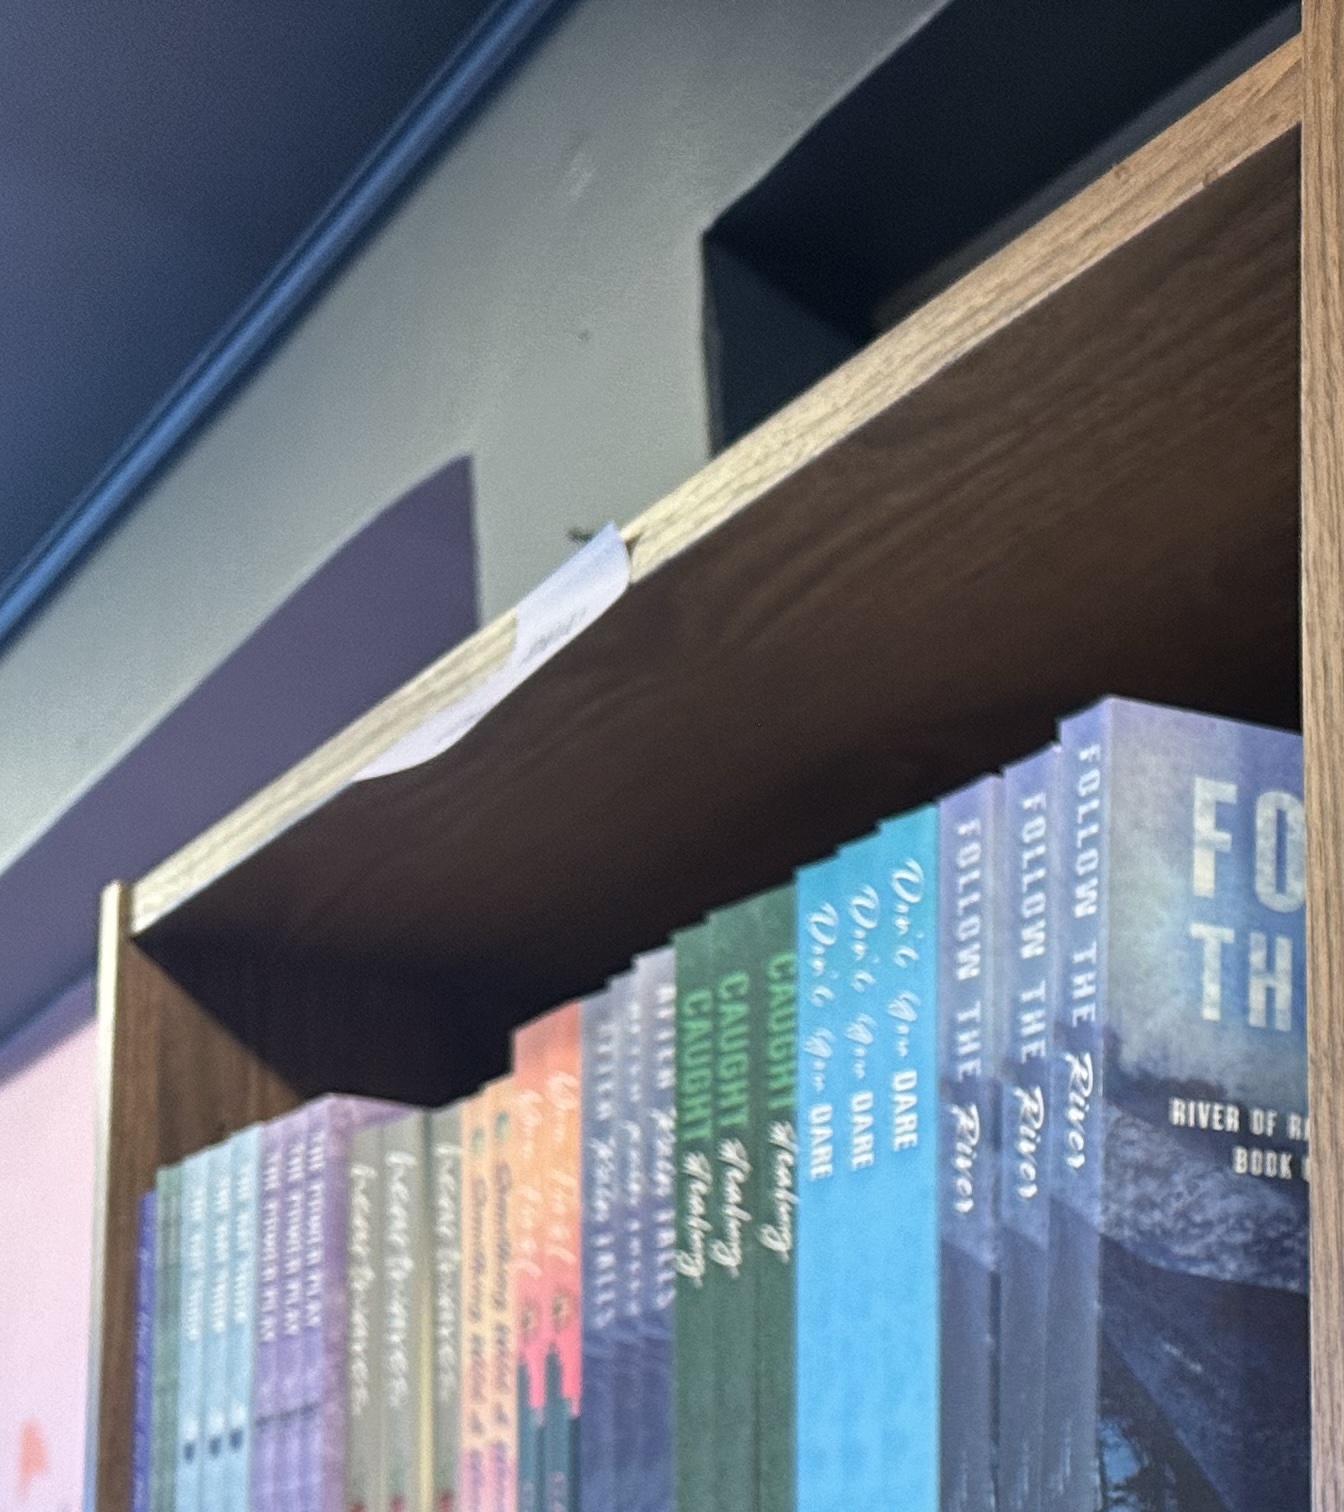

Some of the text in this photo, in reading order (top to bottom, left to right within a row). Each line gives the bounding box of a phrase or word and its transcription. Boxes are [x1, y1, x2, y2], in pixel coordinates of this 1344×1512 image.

[767, 952, 795, 1110] CAUGHT
[950, 820, 982, 1214] FOLLOW THE River
[1012, 791, 1047, 1199] FOLLOW THE River
[1065, 744, 1100, 1170] FOLLOW THE River
[683, 991, 712, 1141] CAUGHT
[718, 971, 749, 1128] CAUGHT
[892, 1070, 917, 1152] DARE
[1170, 1097, 1239, 1132] RIVER
[1250, 1108, 1278, 1137] OF
[810, 1104, 833, 1180] DARE
[851, 1090, 874, 1170] DARE
[1232, 1146, 1292, 1179] BOOK
